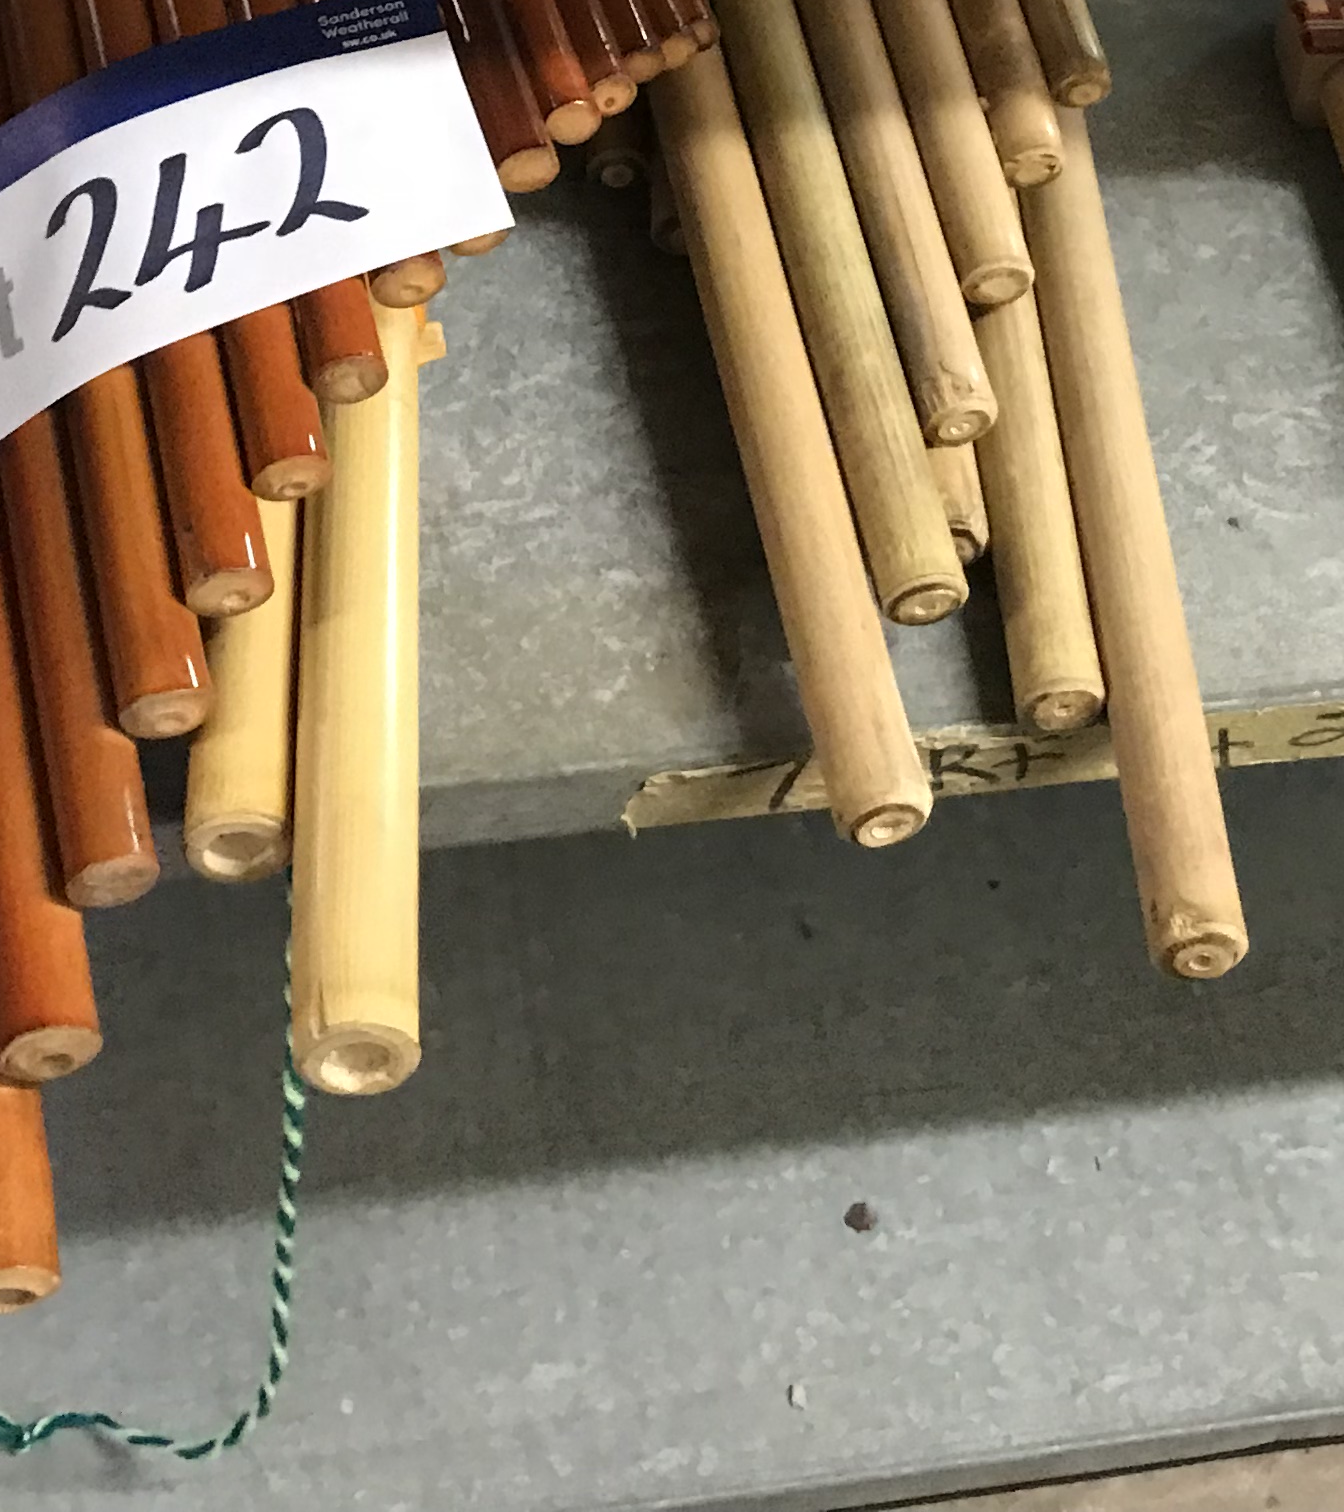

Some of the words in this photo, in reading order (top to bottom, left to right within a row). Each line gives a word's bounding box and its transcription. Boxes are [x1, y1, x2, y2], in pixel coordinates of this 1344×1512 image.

[317, 0, 406, 27] Sanderson
[321, 11, 409, 40] Weatherall
[341, 29, 398, 49] sw.co.uk
[44, 106, 370, 344] 242
